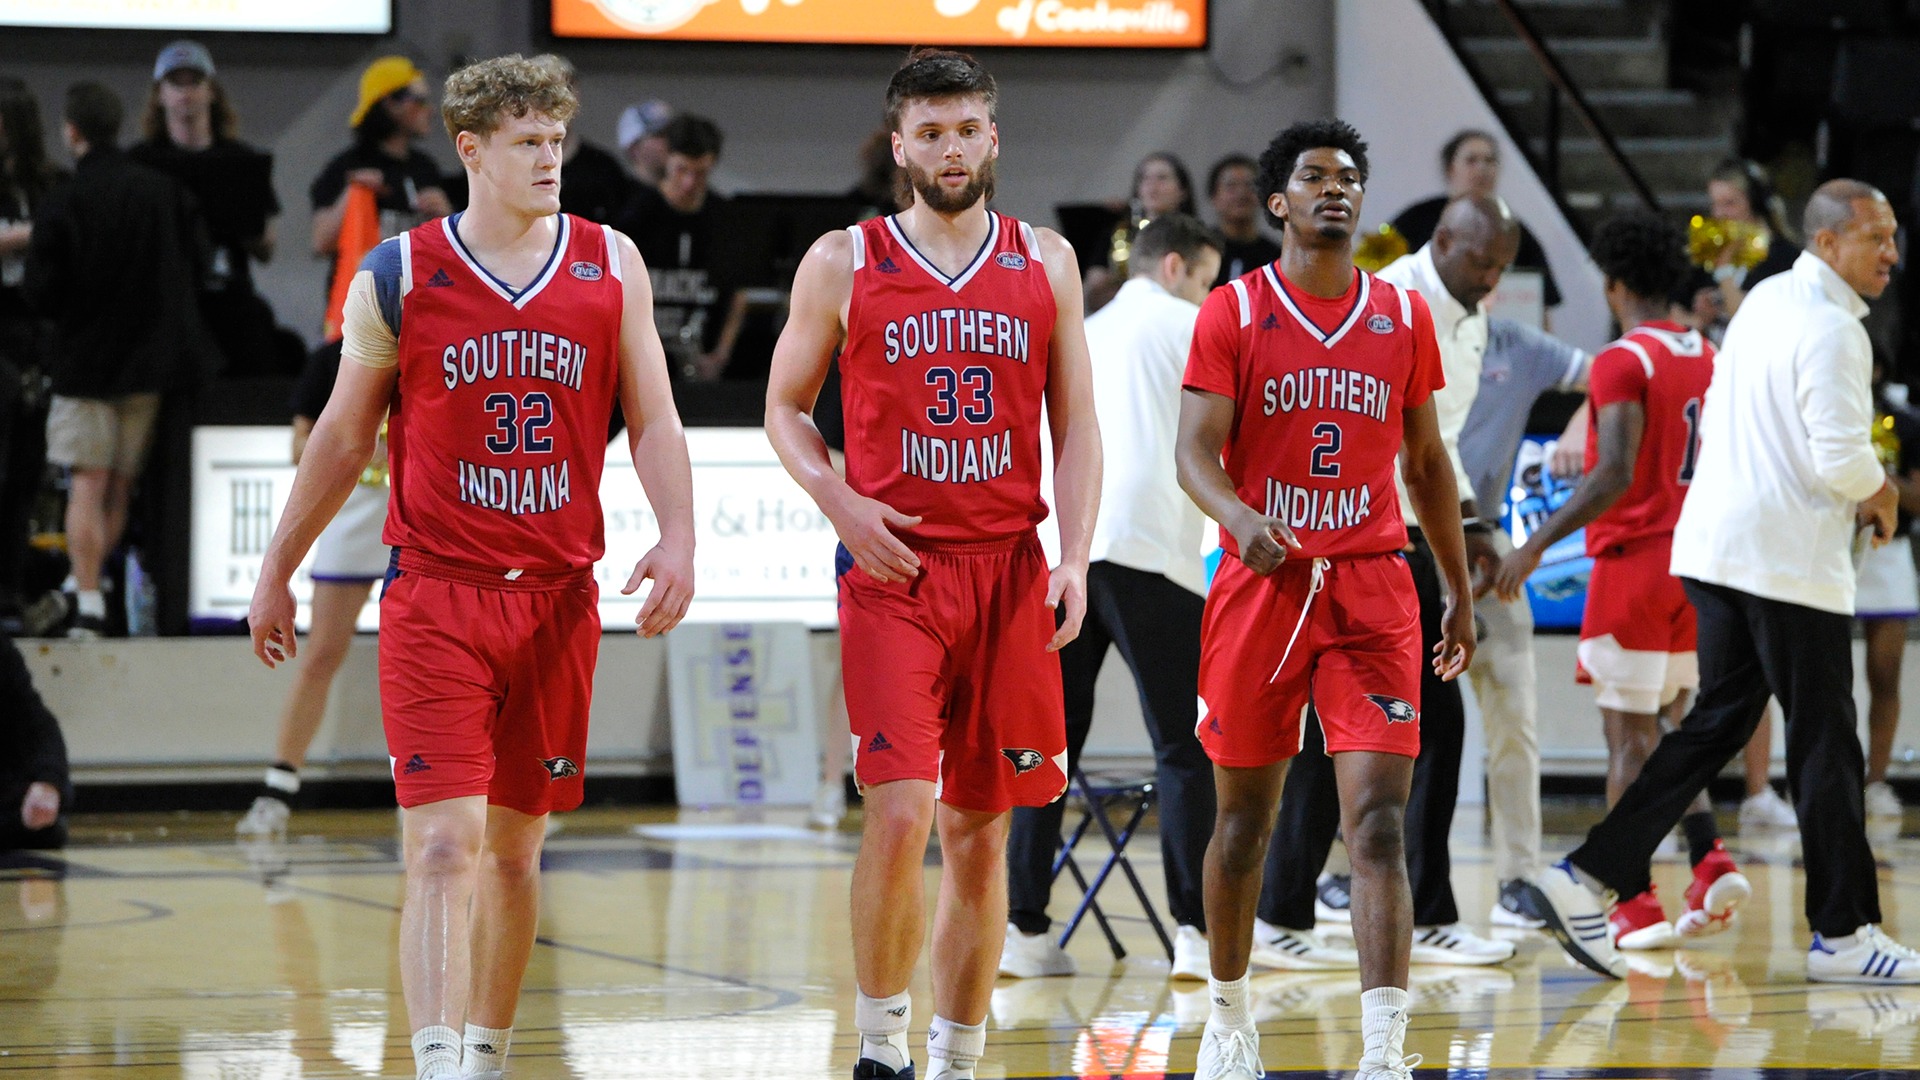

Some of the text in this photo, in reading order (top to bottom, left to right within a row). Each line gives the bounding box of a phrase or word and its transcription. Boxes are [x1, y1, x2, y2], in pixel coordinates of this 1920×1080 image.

[442, 329, 587, 391] SOUTHERN
[884, 307, 1029, 364] SOUTHERN
[484, 391, 553, 454] 32
[925, 366, 994, 425] 33
[1263, 367, 1391, 423] SOUTHERN
[901, 428, 1012, 483] INDIANA
[1309, 421, 1342, 478] 2
[458, 459, 571, 515] INDIANA
[1264, 476, 1371, 530] INDIANA
[722, 623, 765, 803] DEFENSE
